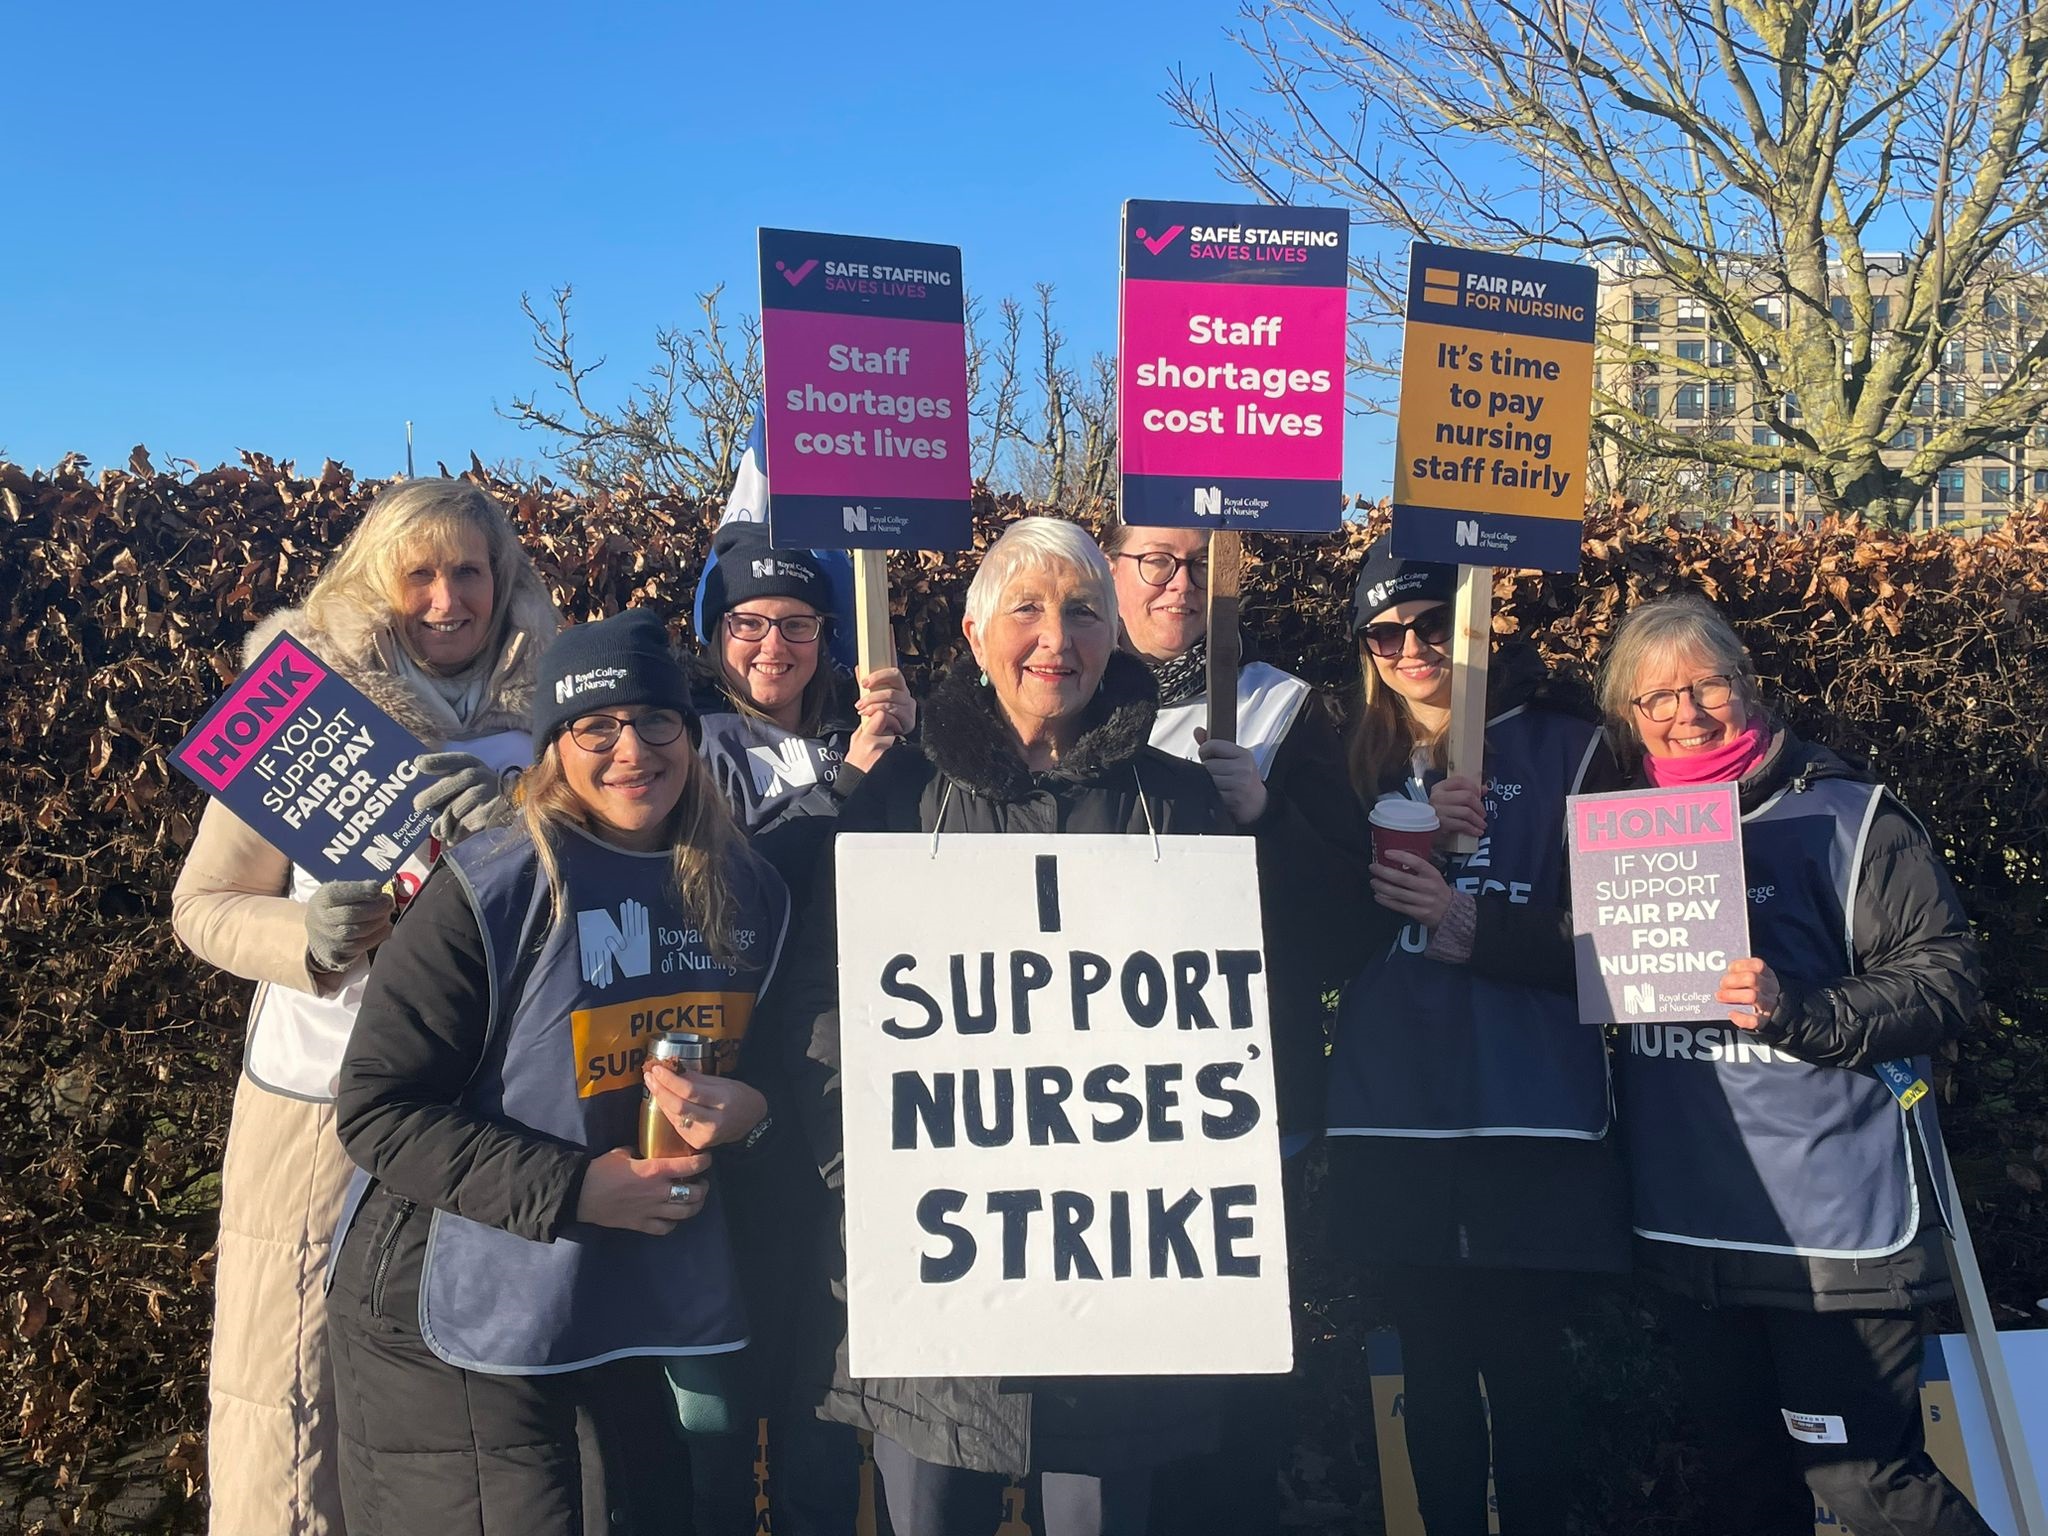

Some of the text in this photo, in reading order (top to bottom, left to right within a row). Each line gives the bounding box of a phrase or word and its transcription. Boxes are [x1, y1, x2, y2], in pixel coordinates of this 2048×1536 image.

[1190, 227, 1338, 247] SAFE STAFFING
[1190, 244, 1307, 263] SAVES LIVES
[825, 261, 951, 286] SAFE STAFFING
[825, 277, 926, 298] SAVES LIVES
[1466, 273, 1547, 299] FAIR PAY
[1465, 293, 1585, 322] FOR NURSING
[1188, 315, 1283, 346] Staff
[828, 344, 910, 376] Staff
[1438, 343, 1560, 381] It's time
[1136, 357, 1331, 398] shortages
[786, 384, 951, 423] shortages
[1450, 383, 1544, 422] to pay
[1142, 404, 1323, 437] cost lives
[794, 429, 948, 460] cost lives
[1435, 422, 1552, 460] nursing
[1412, 456, 1570, 498] staff fairly
[1223, 506, 1259, 518] of Nursing
[1224, 498, 1269, 509] Royal College
[869, 515, 909, 526] Royal College
[869, 524, 901, 534] of Nursing
[575, 669, 595, 684] Royal
[196, 655, 314, 777] HONK
[253, 706, 323, 782] IF YOU
[262, 707, 357, 813] SUPPORT
[824, 765, 839, 782] of
[282, 725, 375, 830] FAIR PAY
[325, 769, 377, 822] FOR
[321, 759, 419, 865] NURSING
[1587, 802, 1723, 843] HONK
[392, 819, 412, 840] Royal
[402, 814, 434, 847] of Nursing
[1614, 850, 1698, 876] IF YOU
[1035, 854, 1061, 932] I
[1595, 874, 1721, 901] SUPPORT
[1598, 899, 1721, 926] FAIR PAY
[1632, 927, 1689, 949] FOR
[661, 951, 674, 974] of
[1599, 951, 1726, 976] NURSING
[880, 949, 1262, 1039] SUPPORT
[1658, 991, 1712, 1003] Royal College
[1659, 1002, 1701, 1014] of Nursing
[630, 1004, 726, 1037] PICKET
[891, 1043, 1261, 1150] NURSES'
[916, 1184, 1261, 1283] STRIKE
